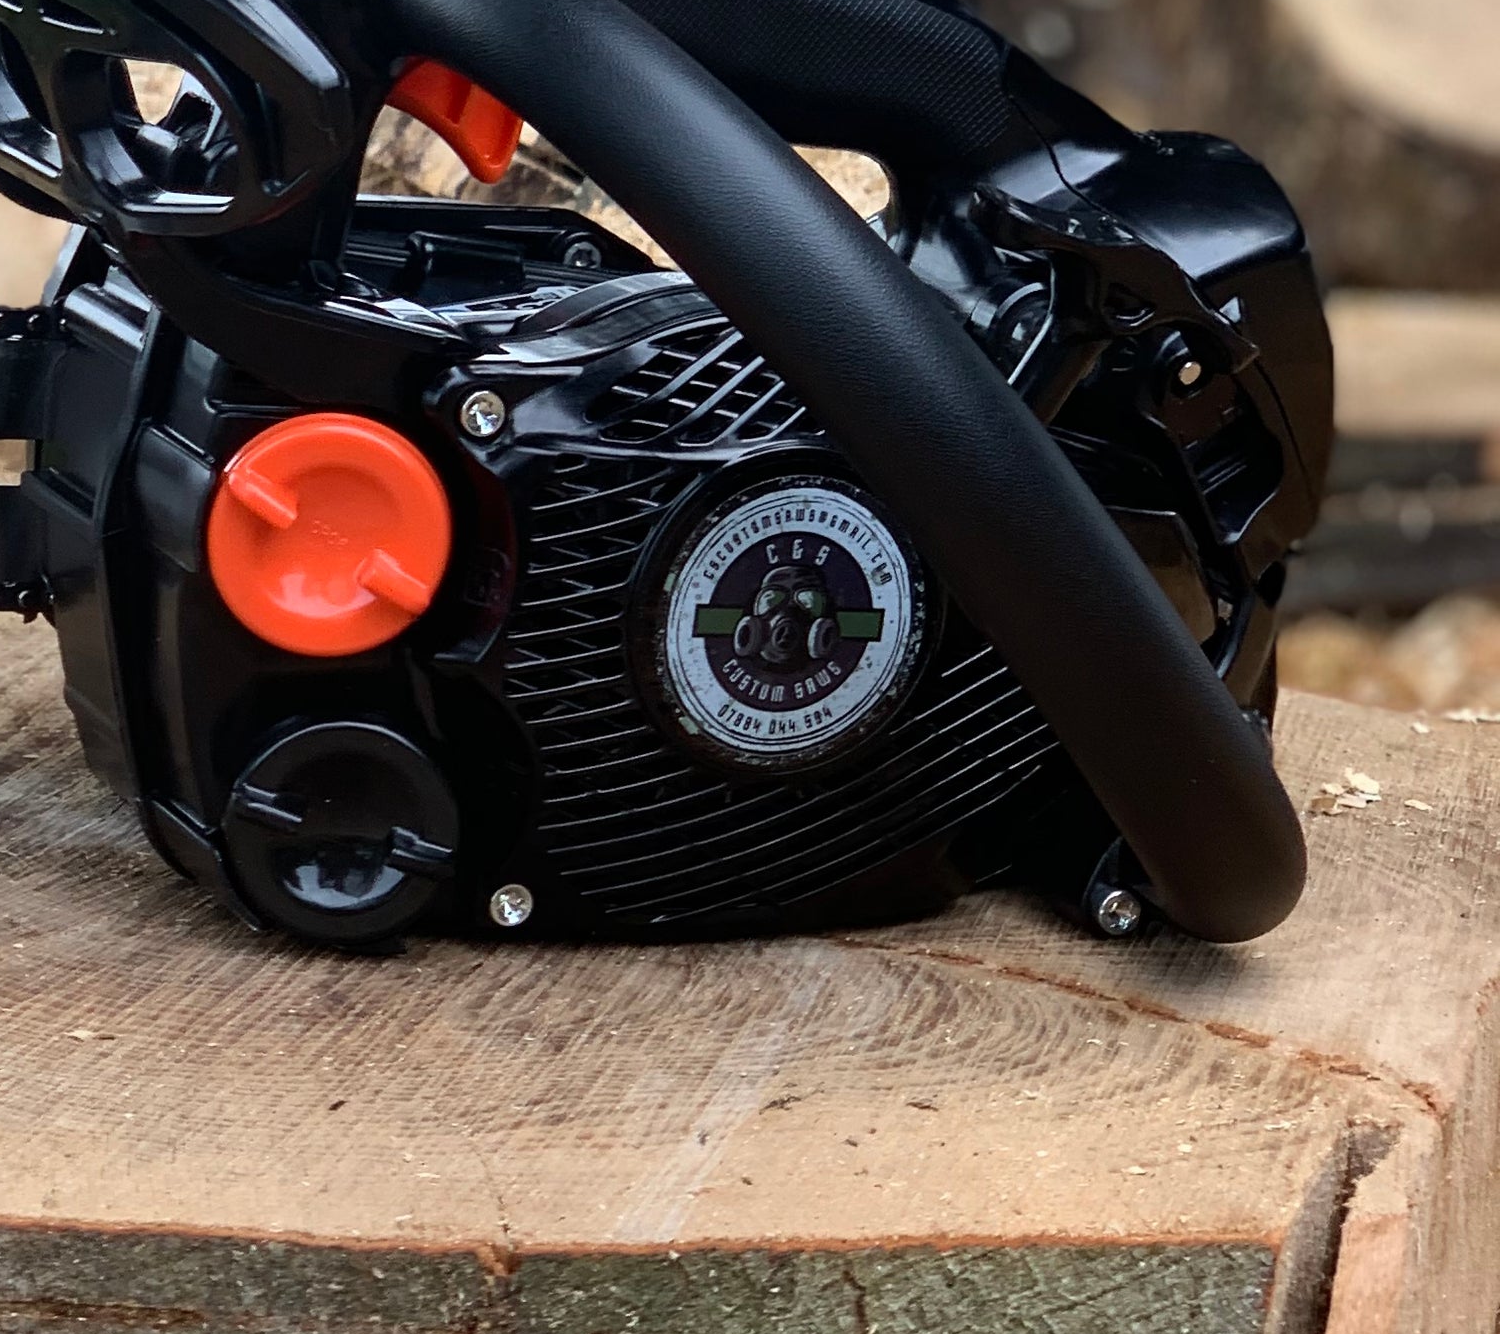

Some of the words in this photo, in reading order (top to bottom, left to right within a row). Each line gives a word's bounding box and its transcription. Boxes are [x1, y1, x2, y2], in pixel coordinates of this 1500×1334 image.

[766, 543, 780, 564] C
[791, 539, 803, 560] &
[814, 545, 831, 566] S
[722, 658, 786, 703] CUSTOM
[793, 660, 842, 700] SAWS
